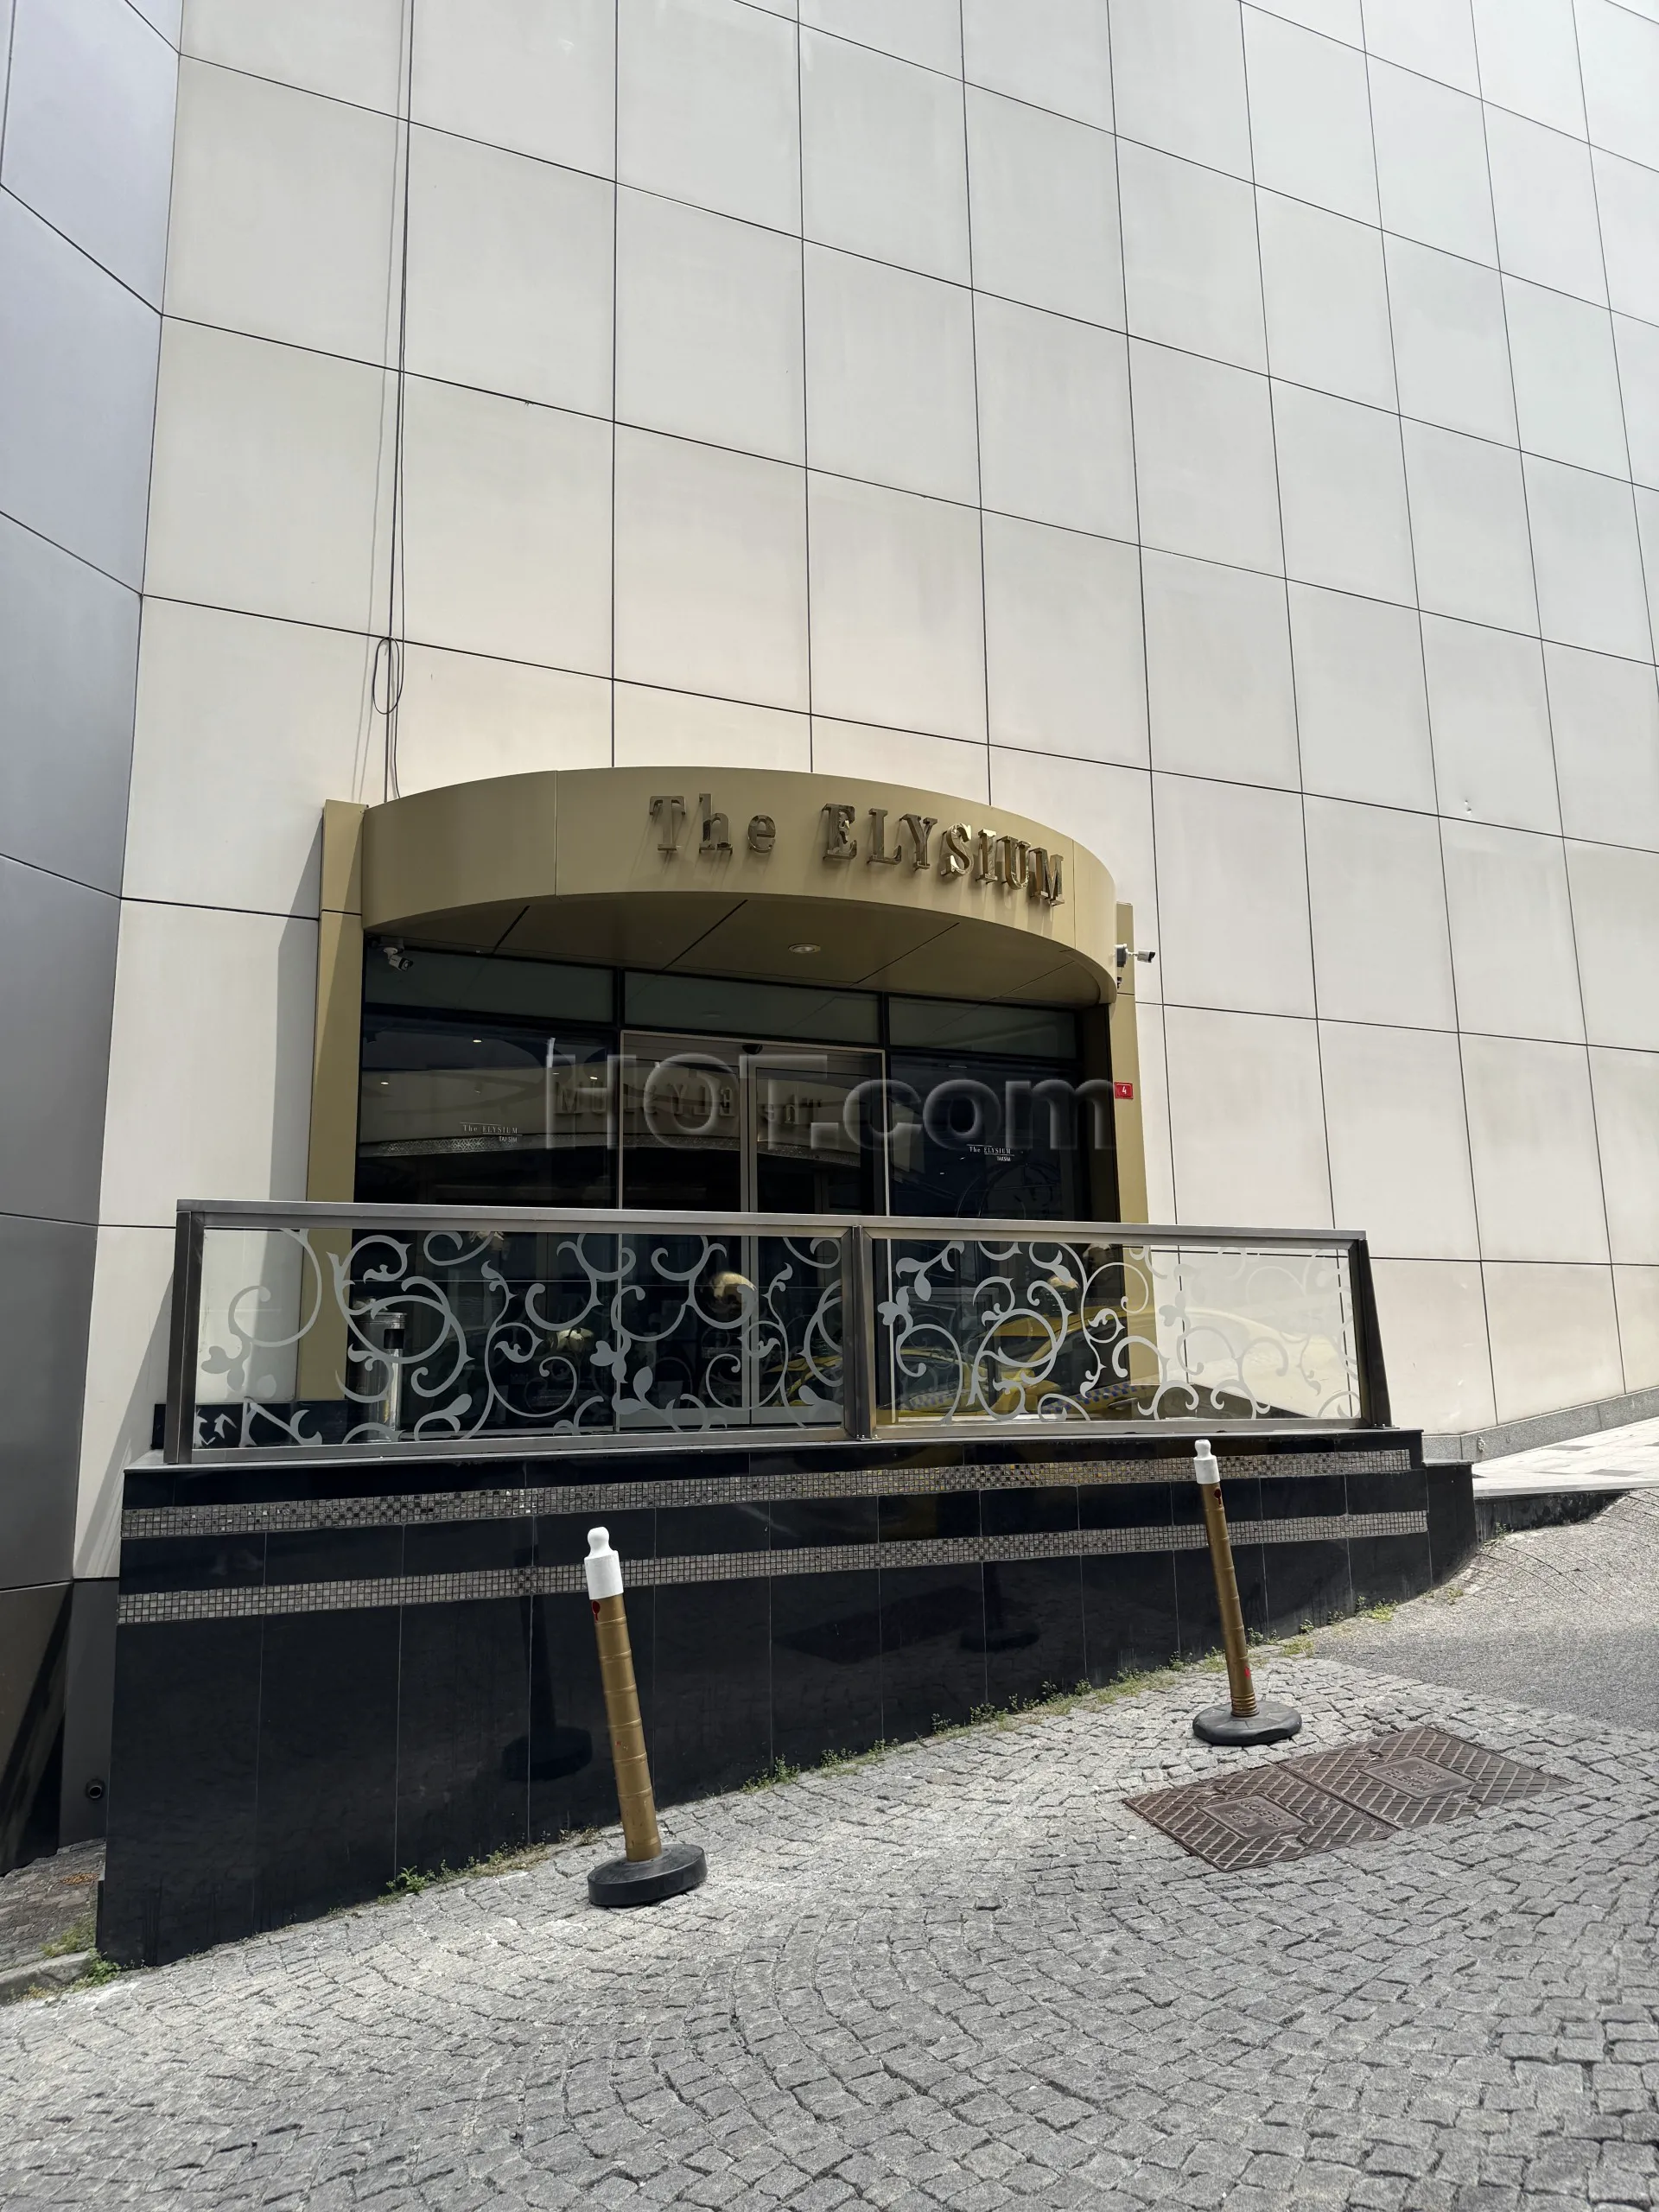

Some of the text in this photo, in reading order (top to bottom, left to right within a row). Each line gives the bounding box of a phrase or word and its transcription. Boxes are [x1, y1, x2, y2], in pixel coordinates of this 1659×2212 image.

[649, 792, 1065, 907] The ELYSIUM
[1122, 1085, 1127, 1095] 4
[482, 1125, 518, 1134] ELYSIUM
